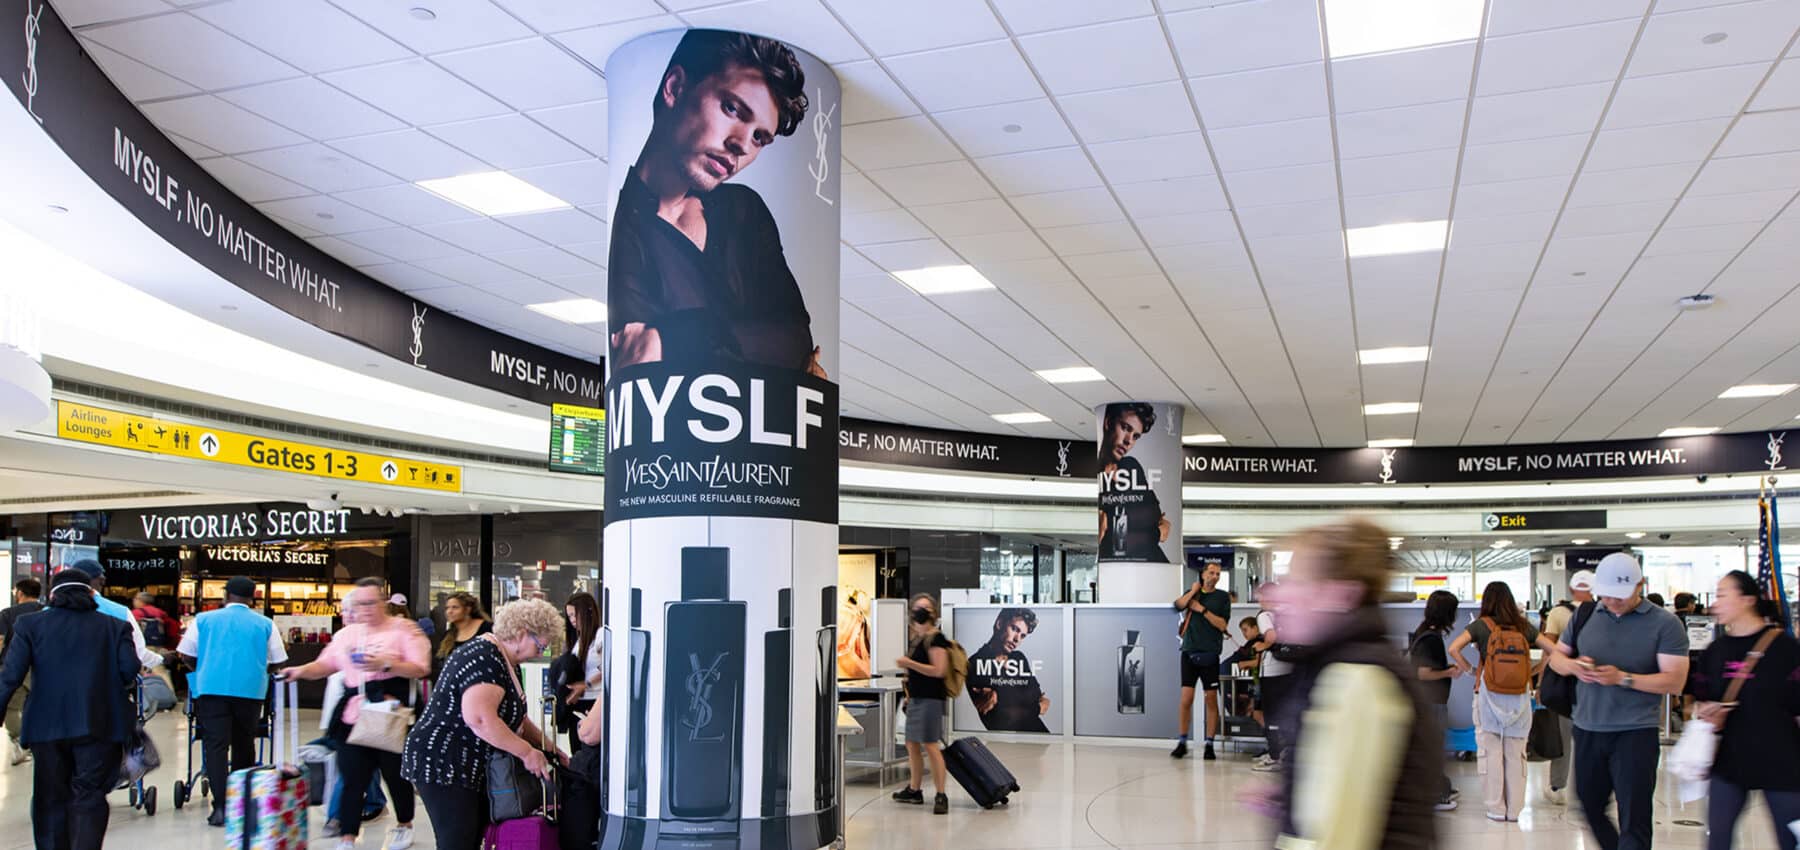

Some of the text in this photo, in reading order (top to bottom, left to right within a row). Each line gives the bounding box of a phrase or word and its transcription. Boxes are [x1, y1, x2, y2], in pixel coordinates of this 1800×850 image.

[114, 126, 342, 312] MYSLF, NO MATTER WHAT.
[491, 350, 550, 390] MYSLF,
[553, 369, 577, 394] NO
[71, 408, 107, 425] Airline
[608, 373, 824, 453] MYSLF
[66, 420, 112, 439] Lounges
[839, 430, 999, 460] SLF, NO MATTER WHAT.
[248, 440, 358, 477] Gates 1-3
[1184, 456, 1317, 473] NO MATTER WHAT.
[1458, 449, 1687, 472] MYSLF, NO MATTER WHAT.
[619, 494, 801, 508] THE NEW MASCULINE REFILLABLE FRAGRANCE
[140, 509, 351, 540] VICTORIA'S SECRET
[1501, 515, 1526, 527] Exit
[207, 548, 281, 563] VICTORIA'S
[284, 551, 329, 565] SECRET
[1239, 557, 1244, 565] 7
[1556, 559, 1562, 567] 6
[976, 658, 1043, 677] MYSLF
